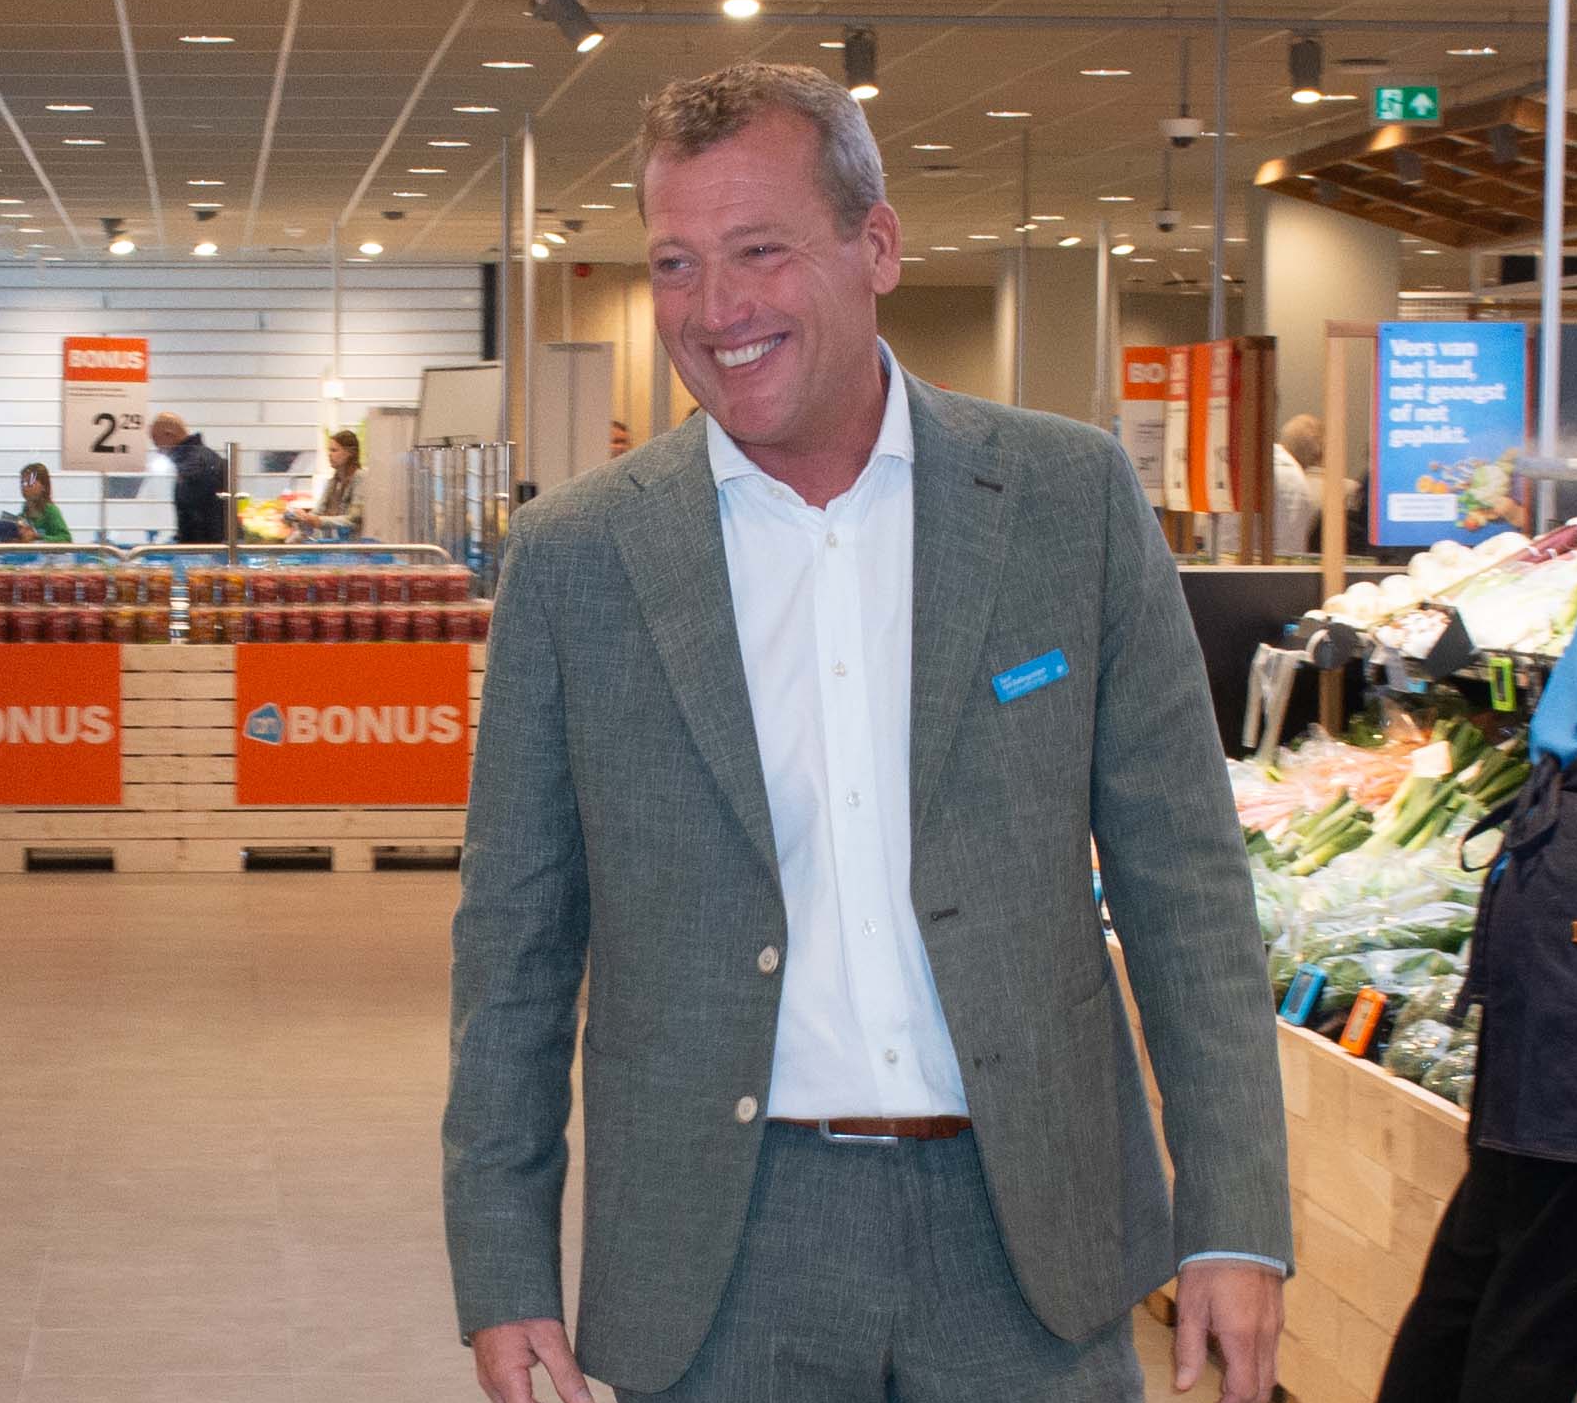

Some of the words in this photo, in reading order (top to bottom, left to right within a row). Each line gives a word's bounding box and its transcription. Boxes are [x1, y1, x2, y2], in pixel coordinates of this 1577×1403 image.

[1390, 339, 1436, 356] Vers
[1439, 341, 1479, 356] van
[67, 349, 146, 370] BONUS
[1390, 360, 1425, 378] het
[286, 704, 462, 745] BONUS
